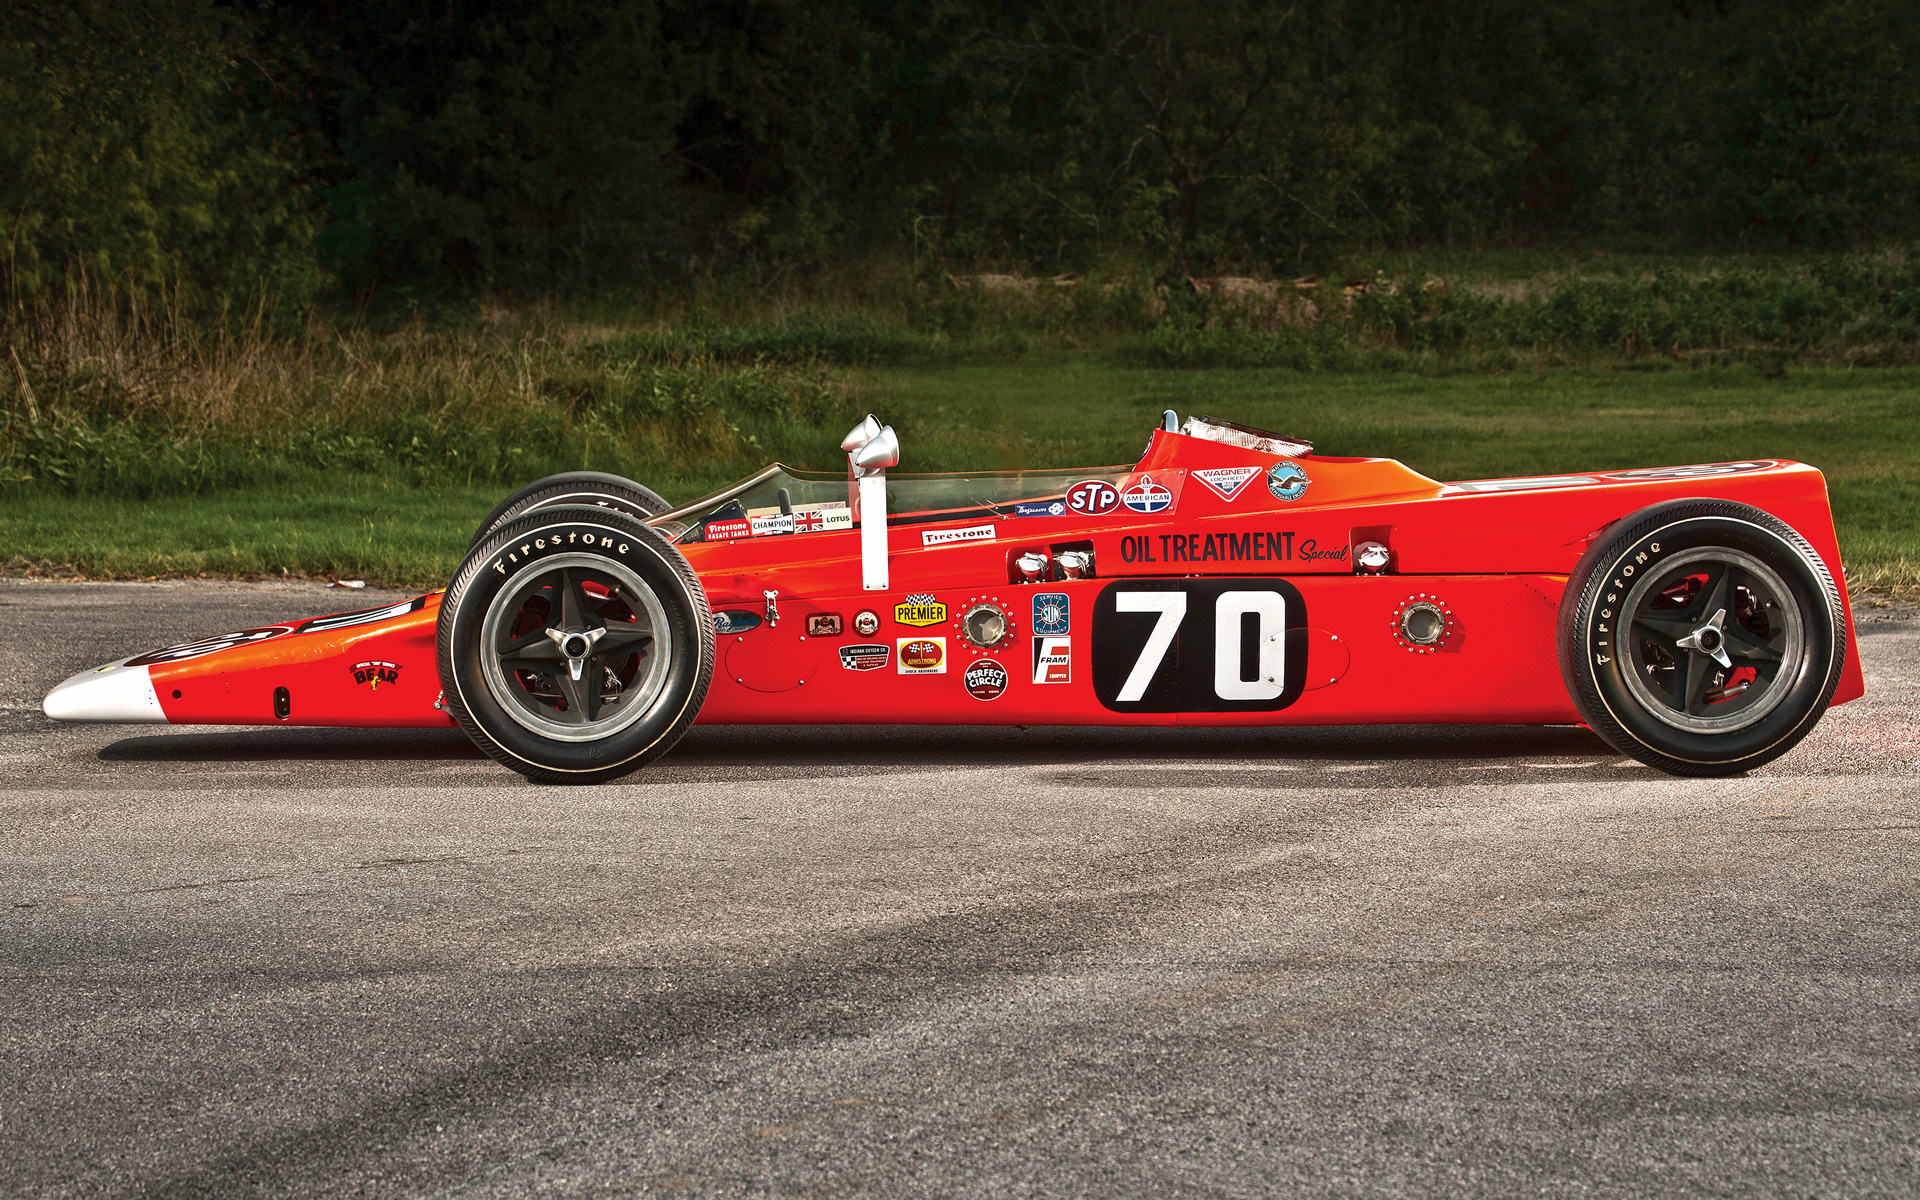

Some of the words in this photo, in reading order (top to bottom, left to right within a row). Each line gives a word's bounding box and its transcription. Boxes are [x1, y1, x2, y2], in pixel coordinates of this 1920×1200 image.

[1203, 468, 1251, 477] WAGNER
[1071, 484, 1116, 512] STP
[1126, 494, 1170, 502] AMERICAN
[752, 519, 792, 530] CHAMPION
[826, 515, 850, 523] LOTUS
[708, 523, 747, 533] Firestone
[730, 529, 749, 537] TANKS
[925, 528, 992, 543] Firestone
[492, 530, 630, 575] Firestone
[1121, 535, 1156, 563] OIL
[1158, 532, 1295, 563] TREATMENT
[1298, 538, 1349, 562] Special
[1596, 542, 1661, 666] Firestone
[898, 606, 943, 621] PREMIER
[1043, 607, 1060, 623] SUN
[1035, 626, 1068, 634] EQUIPMENT
[1115, 590, 1286, 702] 70
[907, 657, 937, 665] ARMSTRONG
[353, 668, 399, 685] BEAR
[966, 668, 1005, 680] PERFECT
[969, 677, 1002, 687] CIRCLE
